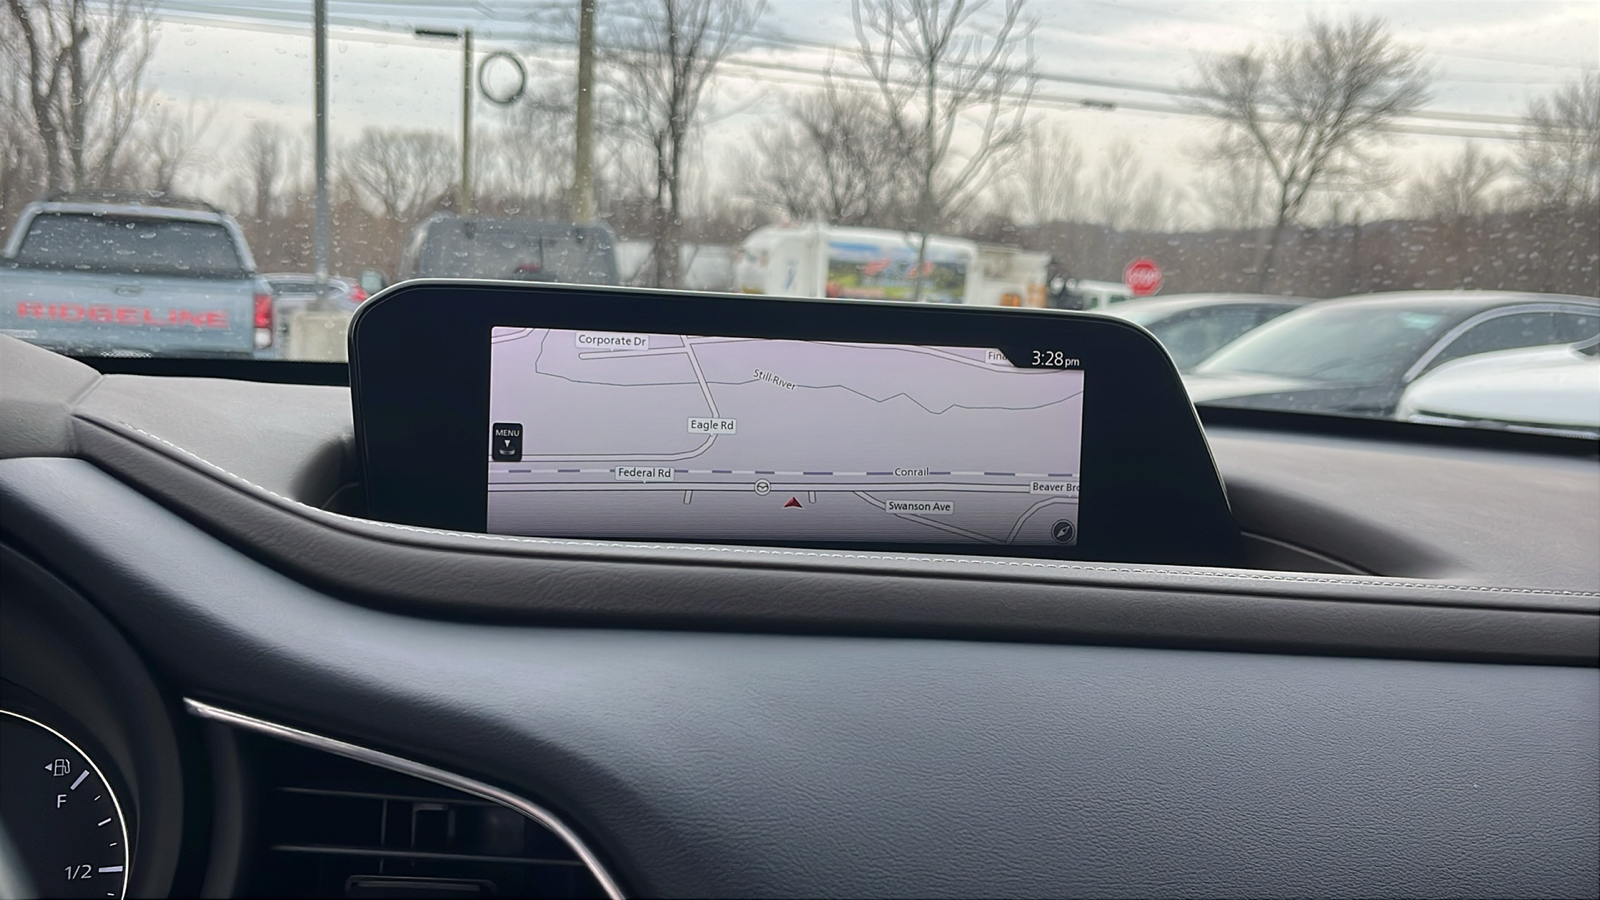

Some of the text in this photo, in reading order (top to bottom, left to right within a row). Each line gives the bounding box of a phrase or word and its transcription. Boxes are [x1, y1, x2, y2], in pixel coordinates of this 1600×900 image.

[17, 302, 229, 328] RIDGELINE
[578, 334, 646, 347] Corporate Dr
[753, 368, 796, 391] Still River
[495, 428, 520, 438] MENU
[691, 420, 734, 433] Eagle Rd
[618, 467, 671, 479] Federal Rd
[894, 467, 929, 477] Conrail
[1032, 482, 1064, 492] Beaver
[888, 501, 951, 512] Swanson Ave
[57, 794, 67, 808] F
[64, 864, 92, 880] 1/2
